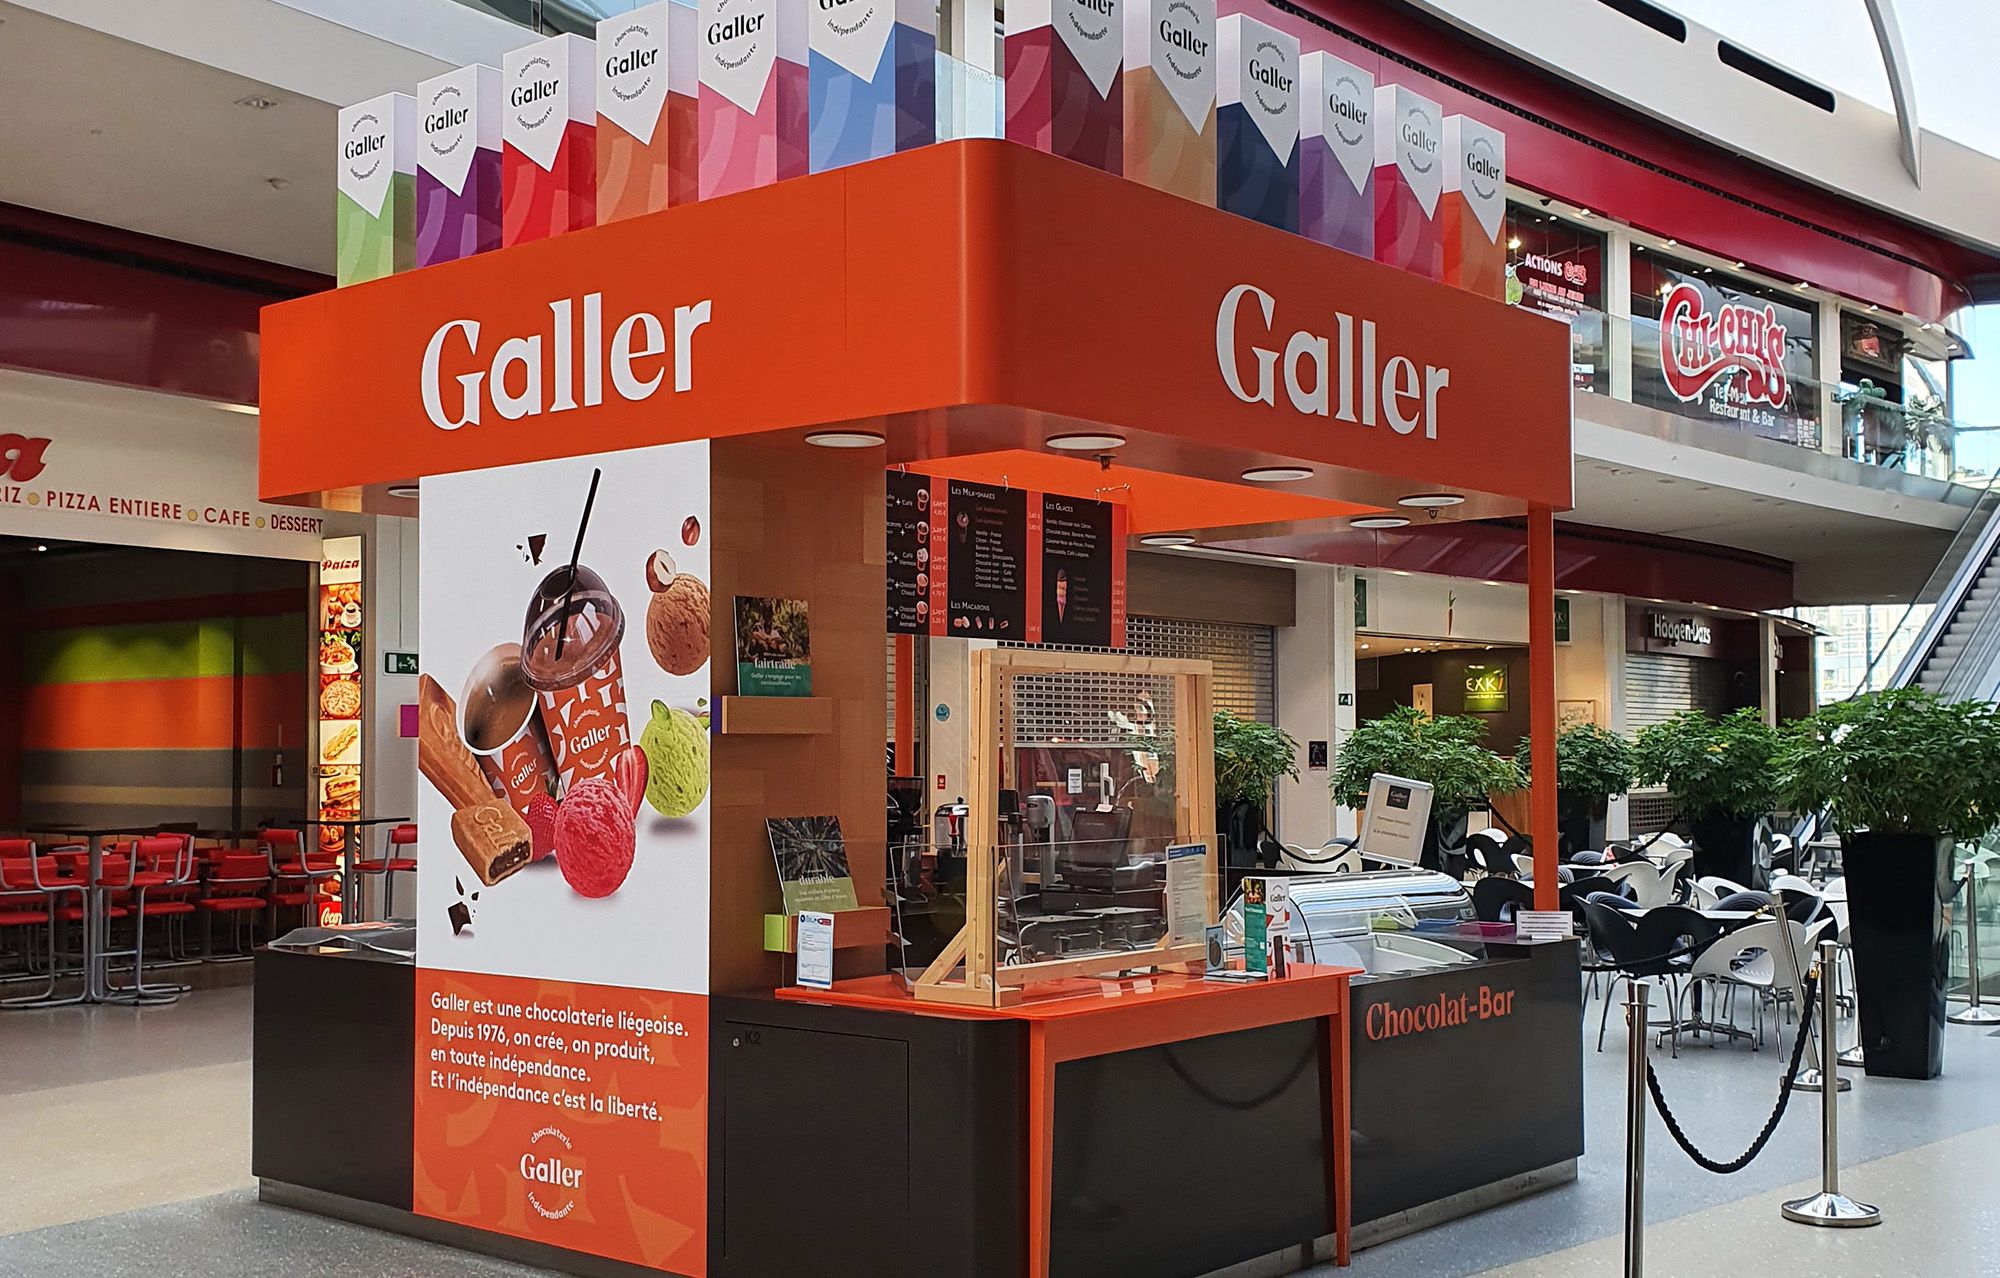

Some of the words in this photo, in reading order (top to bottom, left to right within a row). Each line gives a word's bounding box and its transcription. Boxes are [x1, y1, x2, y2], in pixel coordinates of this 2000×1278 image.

[708, 13, 765, 46] Galler
[1160, 19, 1209, 58] Galler
[605, 48, 658, 78] Galler
[1249, 58, 1293, 94] Galler
[511, 79, 559, 108] Galler
[1329, 92, 1368, 125] Galler
[424, 107, 469, 134] Galler
[344, 134, 386, 160] Galler
[1402, 122, 1438, 154] Galler
[1467, 151, 1500, 181] Galler
[1525, 252, 1563, 277] ACTIONS
[420, 291, 712, 431] Galler
[1215, 283, 1450, 440] Galler
[1709, 398, 1750, 421] Restaurant
[1752, 409, 1761, 424] &
[1762, 411, 1776, 427] Bar
[0, 486, 21, 503] IZ
[47, 490, 101, 512] PIZZA
[109, 497, 182, 520] ENTIERE
[204, 507, 251, 527] CAFE
[271, 514, 324, 534] DESSERT
[754, 657, 796, 670] fairtrade
[570, 724, 611, 754] Galler
[511, 757, 537, 789] Galler
[431, 992, 470, 1013] Galler
[473, 998, 493, 1016] est
[497, 1003, 522, 1018] une
[525, 1003, 614, 1028] chocolaterie
[618, 1011, 689, 1037] liégeoise.
[1366, 985, 1515, 1041] Chocolat-Bar
[431, 1018, 475, 1041] Depuis
[477, 1024, 510, 1047] 1976,
[513, 1032, 531, 1047] on
[534, 1033, 568, 1054] crée,
[572, 1038, 590, 1054] on
[594, 1041, 655, 1065] produit,
[430, 1048, 446, 1063] en
[449, 1048, 486, 1068] toute
[489, 1052, 591, 1082] indépendance.
[431, 1070, 444, 1088] Et
[447, 1073, 550, 1104] l'indépendance
[553, 1089, 586, 1111] c'est
[590, 1093, 604, 1113] la
[607, 1096, 663, 1122] liberté.
[531, 1125, 572, 1150] chocolaterie
[520, 1153, 583, 1189] Galler
